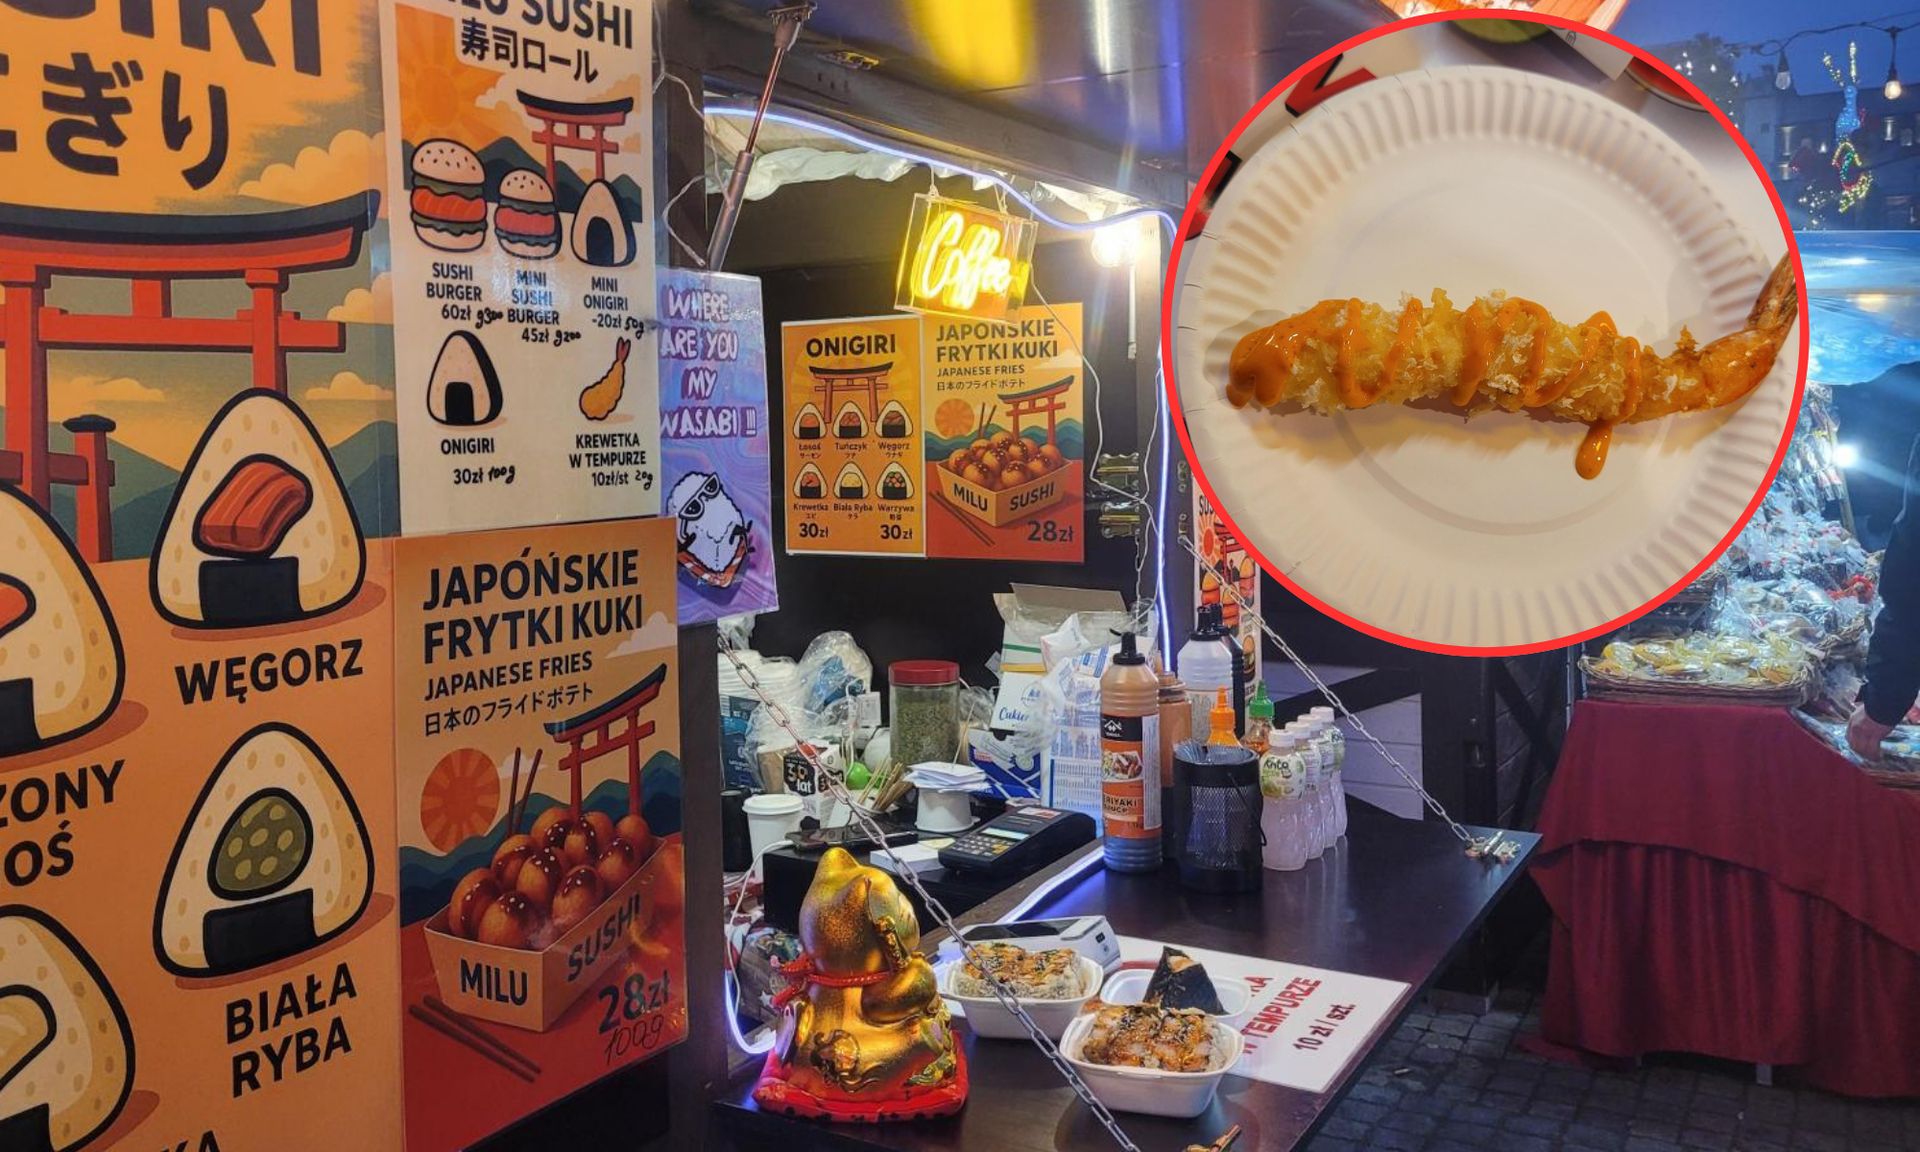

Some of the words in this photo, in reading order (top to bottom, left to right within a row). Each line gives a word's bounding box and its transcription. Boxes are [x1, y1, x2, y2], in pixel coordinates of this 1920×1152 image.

[521, 0, 633, 50] SUSHI
[461, 16, 599, 84] 寿司ロール
[0, 52, 230, 191] ぎり
[916, 211, 1012, 311] Coffee
[432, 262, 473, 282] SUSHI
[516, 270, 547, 287] MINI
[426, 282, 482, 302] BURGER
[591, 276, 618, 293] MINI
[511, 288, 553, 306] SUSHI
[583, 294, 629, 311] ONIGIRI
[667, 286, 731, 322] WHERE
[441, 303, 472, 321] 60zł
[507, 308, 560, 326] BURGER
[521, 327, 549, 343] 45zł
[660, 331, 698, 360] ARE
[704, 331, 739, 361] YOU
[806, 333, 896, 358] ONIGIRI
[936, 344, 1007, 364] FRYTKI
[1012, 340, 1058, 359] KUKI
[937, 365, 991, 378] JAPANESE
[994, 364, 1025, 375] FRIES
[686, 368, 718, 398] MY
[936, 378, 1026, 392] 日本のフライドポテト
[659, 406, 739, 439] WASABI
[440, 438, 495, 455] ONIGIRI
[575, 433, 640, 449] KREWETKA
[835, 441, 868, 452] Tuńczyk
[569, 453, 582, 469] W
[584, 450, 647, 468] TEMPURZE
[453, 468, 484, 485] 30zł
[591, 472, 629, 487] 10zł/st
[793, 502, 829, 512] Krewetka
[953, 482, 988, 512] MILU
[1009, 482, 1055, 512] SUSHI
[854, 503, 873, 513] Ryba
[877, 503, 915, 514] Warzywa
[799, 522, 829, 538] 30zł
[880, 524, 913, 540] 30zł
[1027, 520, 1074, 544] 28zł
[423, 605, 563, 665] FRYTKI
[572, 594, 643, 640] KUKI
[175, 638, 364, 705] WĘGORZ
[424, 661, 533, 701] JAPANESE
[539, 651, 593, 680] FRIES
[424, 682, 594, 737] 日本のフライドポテト
[0, 759, 126, 828] ONY
[796, 778, 812, 793] lat
[1103, 795, 1137, 807] RIYAKI
[567, 893, 641, 982] SUSHI
[460, 958, 528, 1006] MILU
[226, 962, 357, 1045] BIAŁA
[597, 969, 670, 1035] 28zł
[1240, 977, 1322, 1039] TEMPURZE
[1293, 1037, 1323, 1051] 10
[232, 1016, 352, 1099] RYBA
